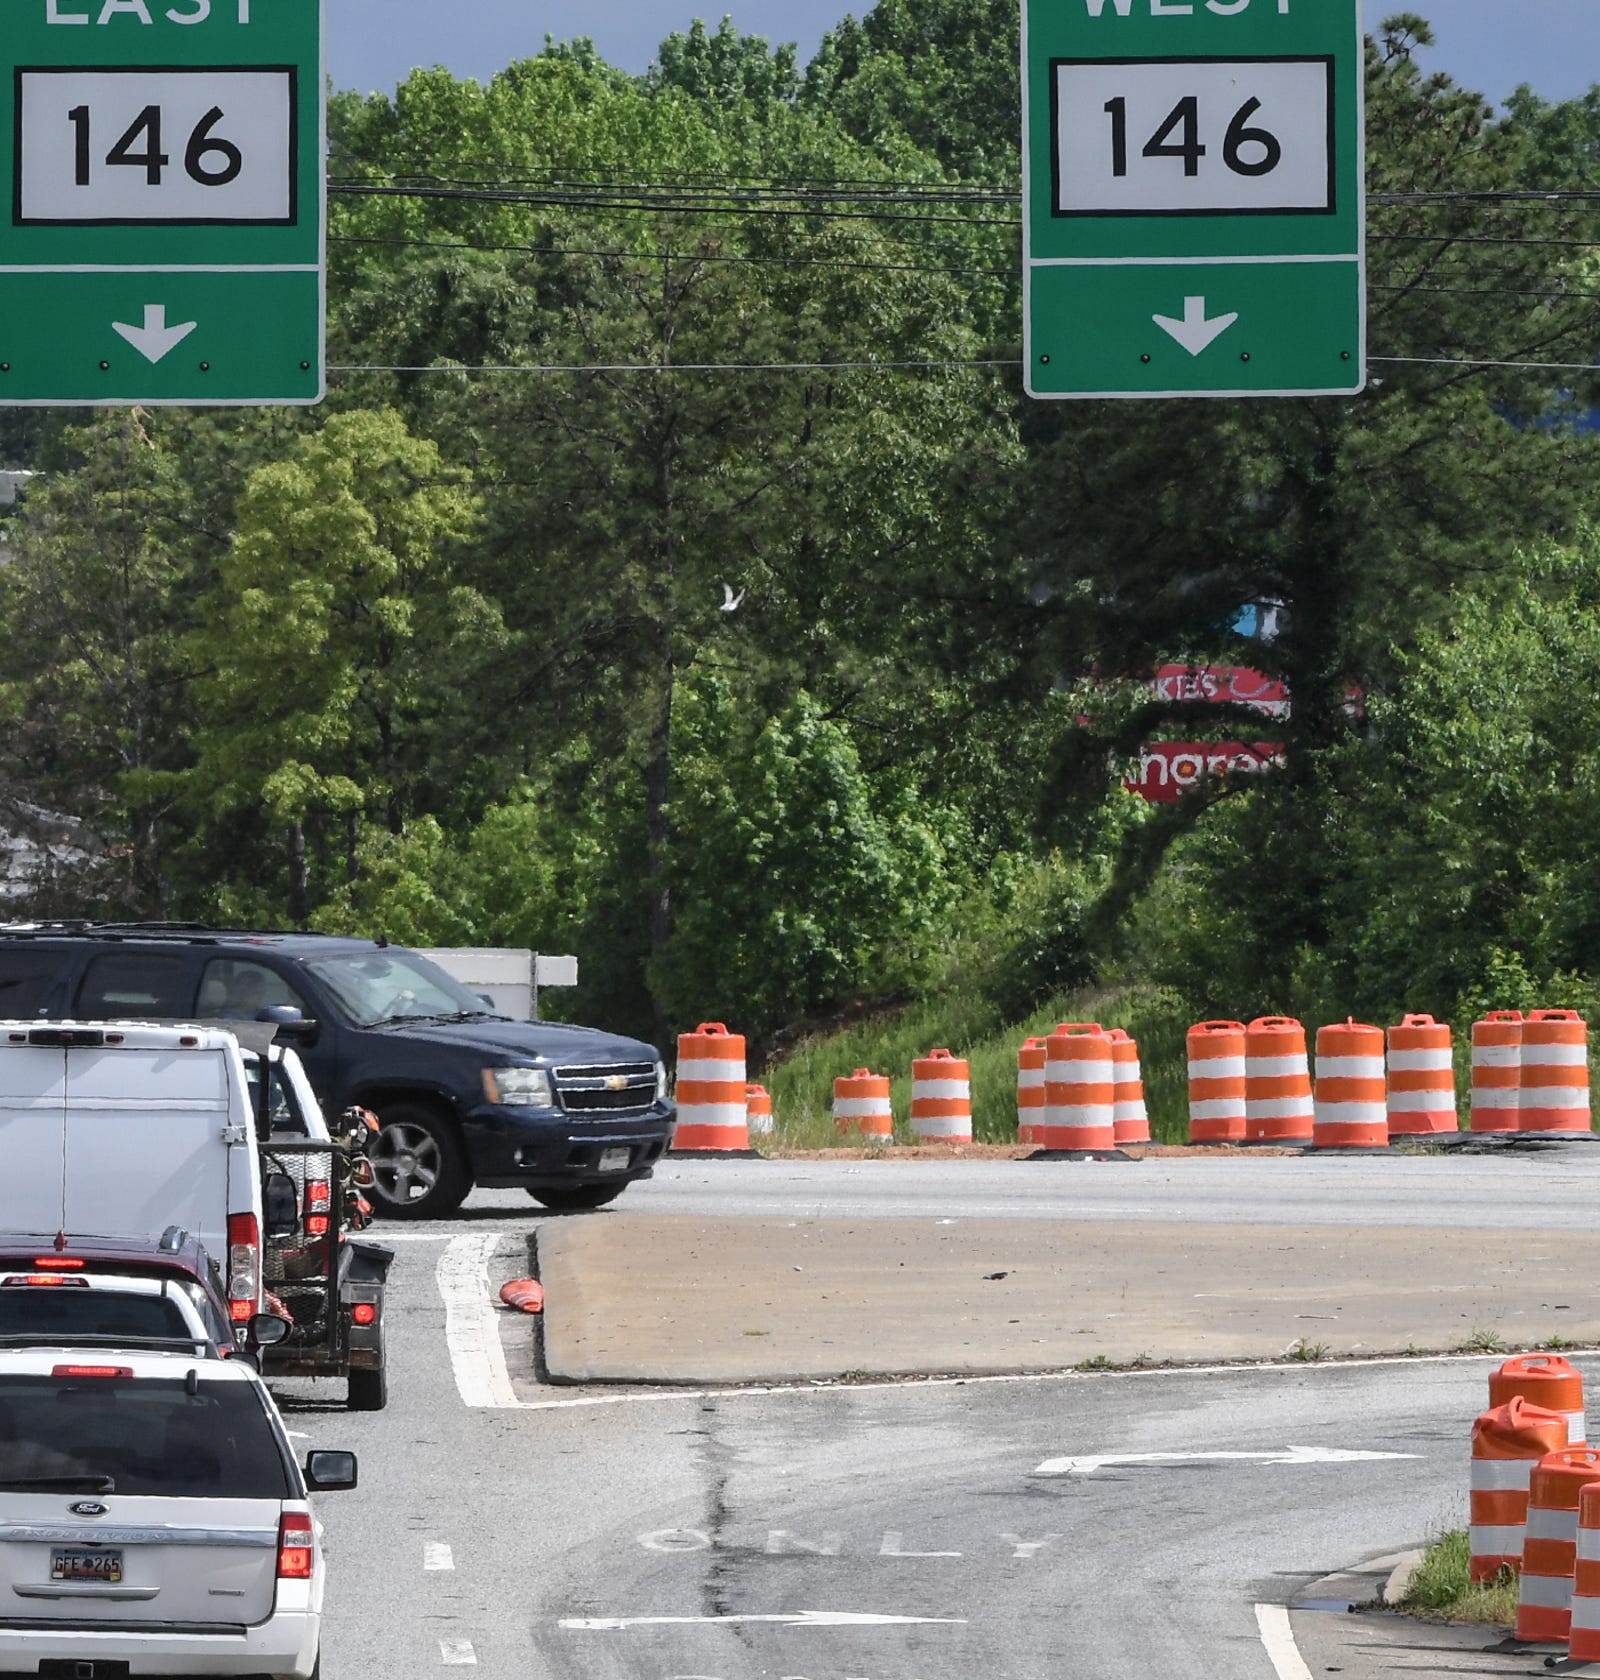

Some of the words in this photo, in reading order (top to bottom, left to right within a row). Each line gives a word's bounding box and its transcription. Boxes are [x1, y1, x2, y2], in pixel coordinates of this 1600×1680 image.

[68, 105, 242, 186] 146
[1103, 96, 1281, 177] 146
[55, 1557, 80, 1573] GFE
[94, 1557, 120, 1573] 265
[636, 1528, 1064, 1558] ONLY
